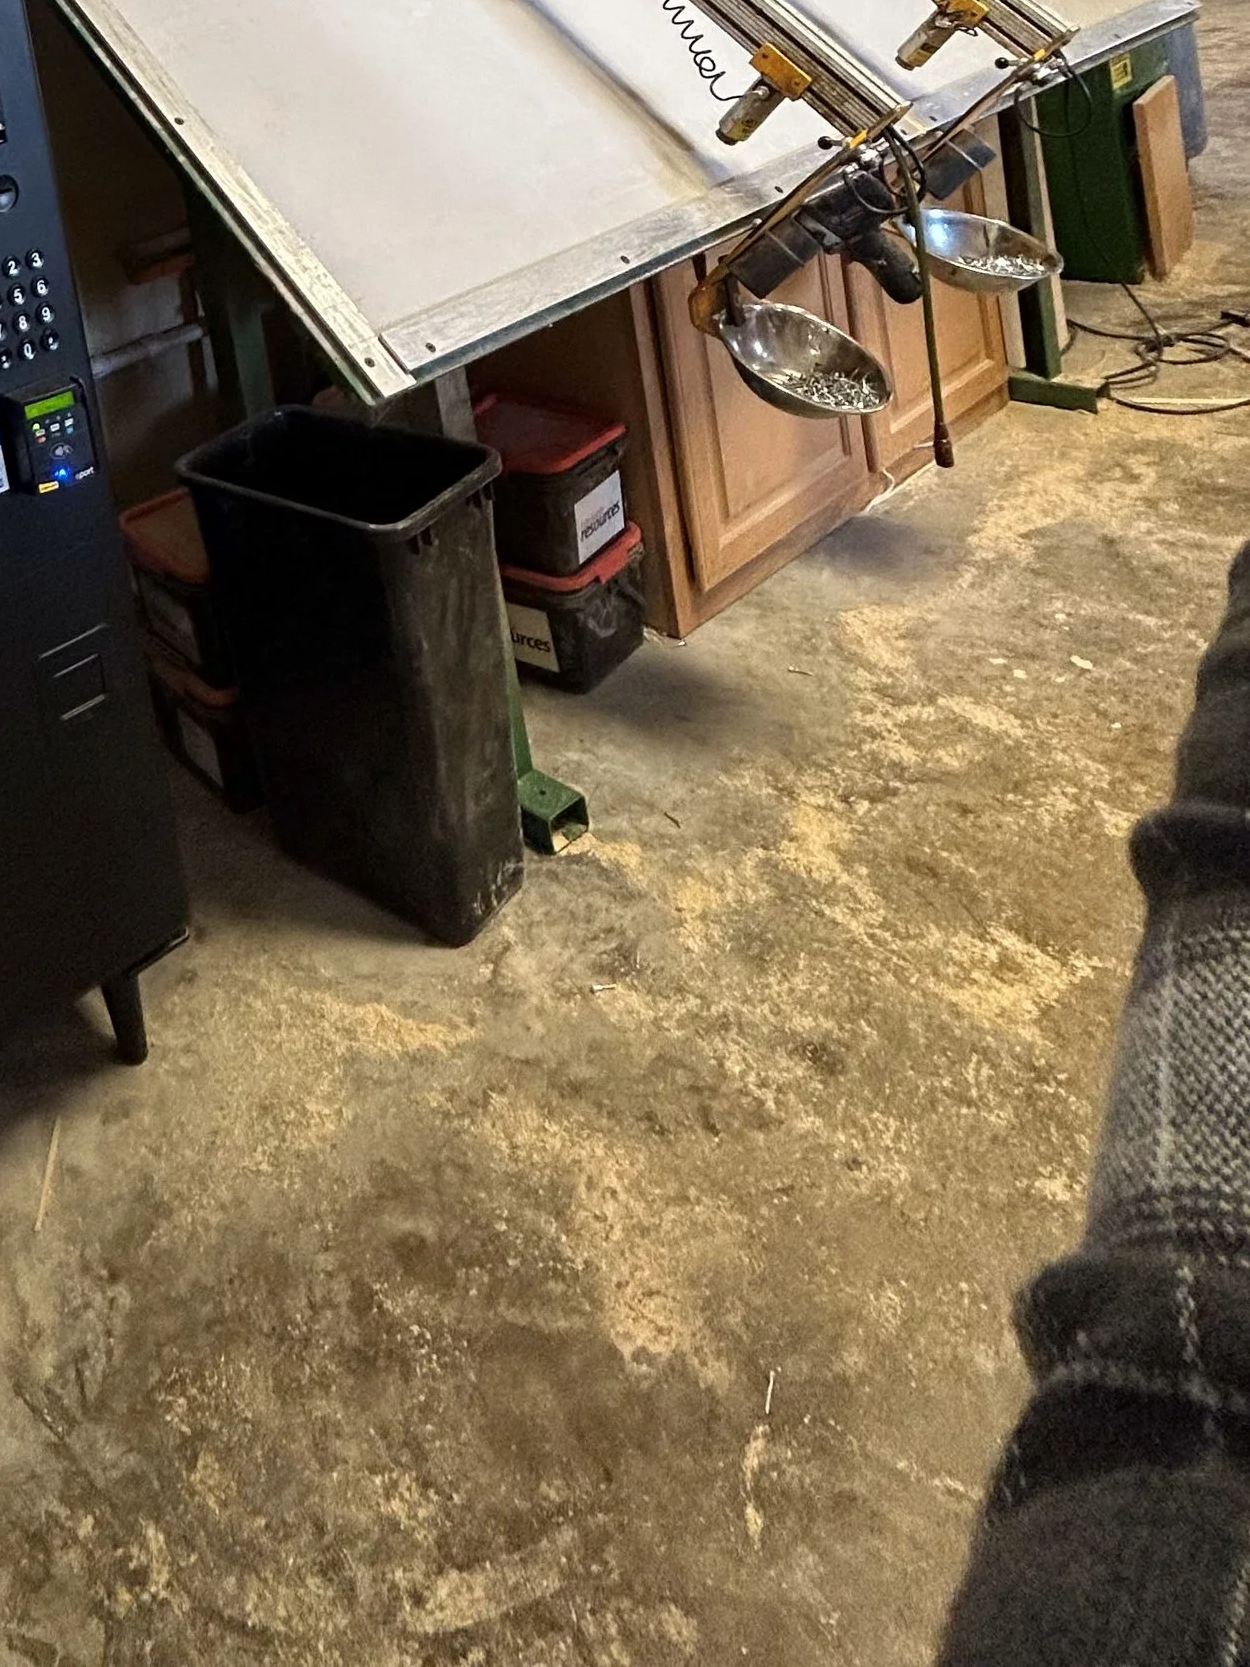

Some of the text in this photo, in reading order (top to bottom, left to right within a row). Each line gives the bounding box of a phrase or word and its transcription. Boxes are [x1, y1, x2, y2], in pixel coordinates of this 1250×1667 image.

[8, 260, 19, 275] 2
[31, 252, 43, 268] 3
[13, 288, 24, 305] 5
[37, 279, 47, 295] 6
[18, 315, 28, 330] 8
[41, 306, 51, 323] 9
[23, 343, 34, 360] 0
[579, 500, 621, 543] resources
[511, 632, 551, 654] urces
